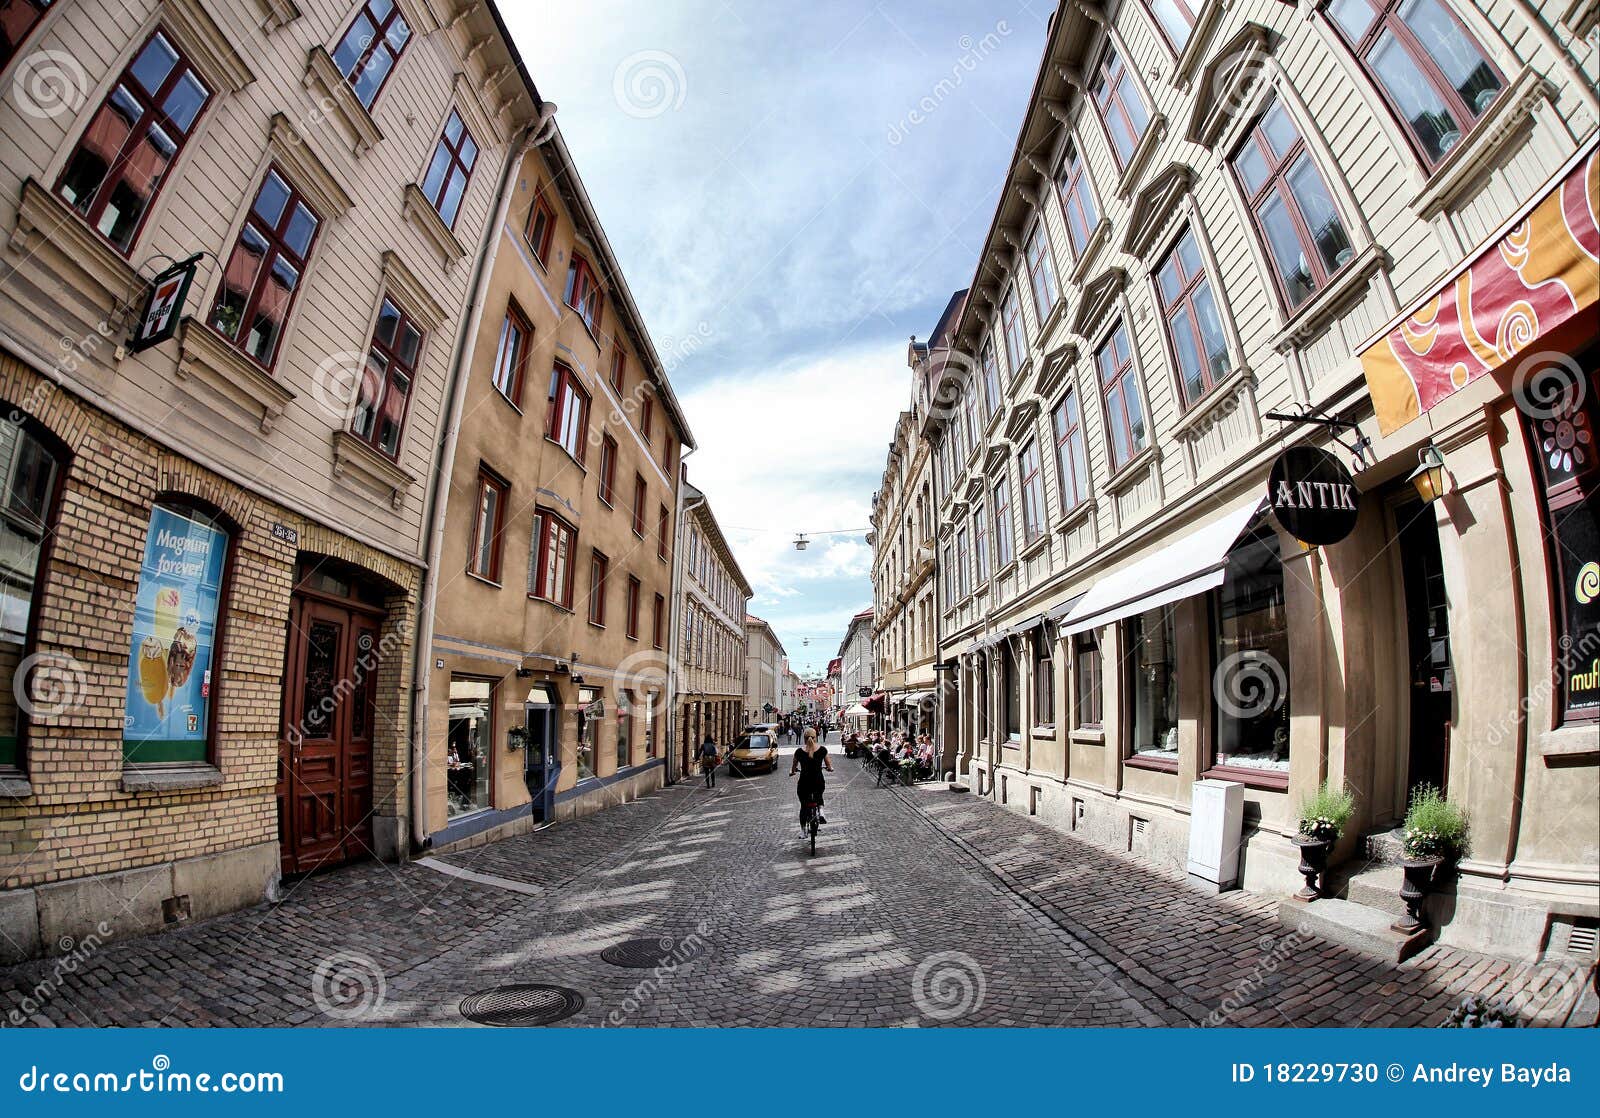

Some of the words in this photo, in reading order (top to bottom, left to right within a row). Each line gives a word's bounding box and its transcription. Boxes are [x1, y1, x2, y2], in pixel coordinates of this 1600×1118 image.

[1275, 480, 1357, 511] ANTIK
[156, 528, 210, 556] Magnum
[155, 553, 204, 578] forever!
[1571, 658, 1600, 692] muf
